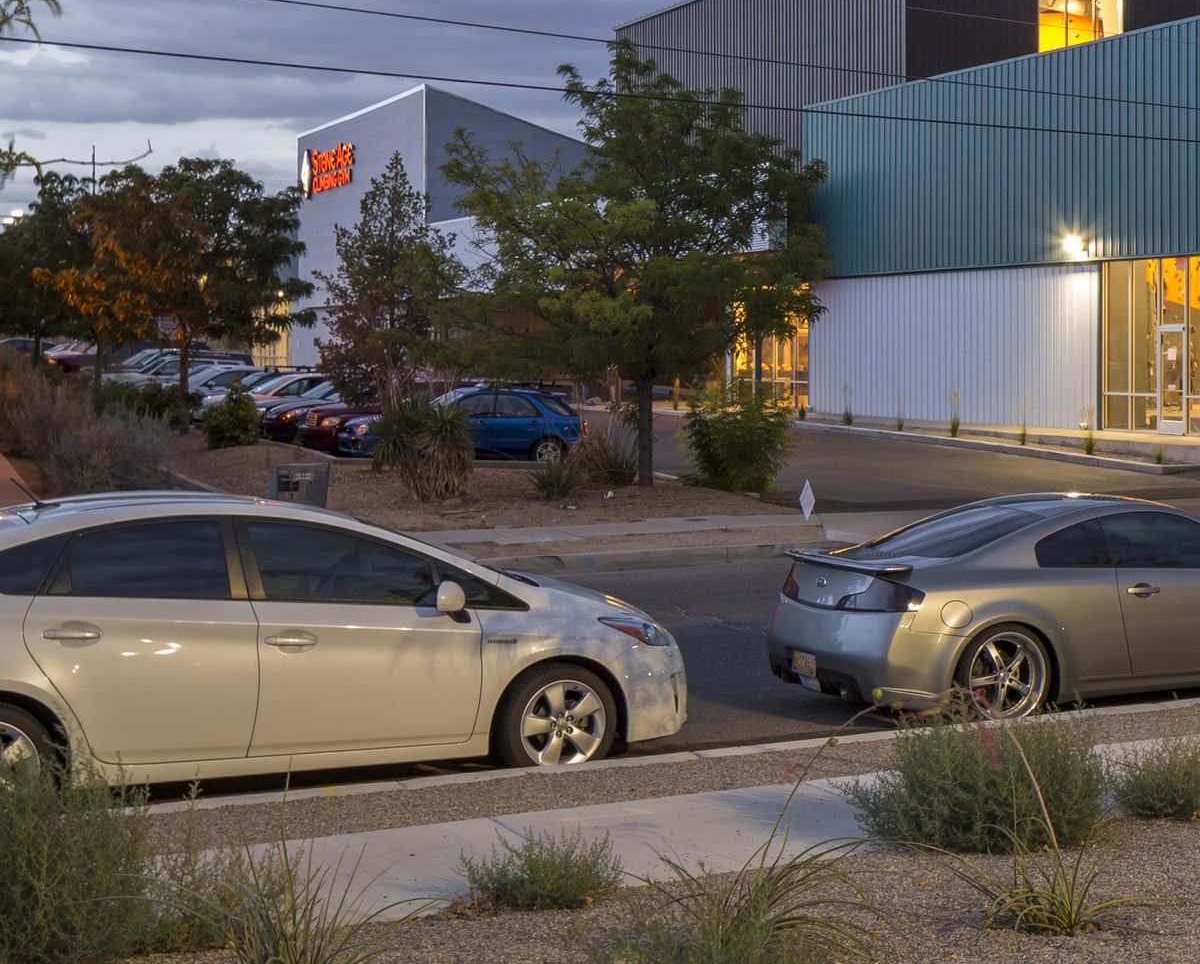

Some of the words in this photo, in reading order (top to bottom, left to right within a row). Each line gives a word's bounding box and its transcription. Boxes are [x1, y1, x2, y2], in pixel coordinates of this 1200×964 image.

[337, 143, 353, 167] AGE
[312, 172, 337, 193] CLIMBING
[338, 168, 350, 187] GYM
